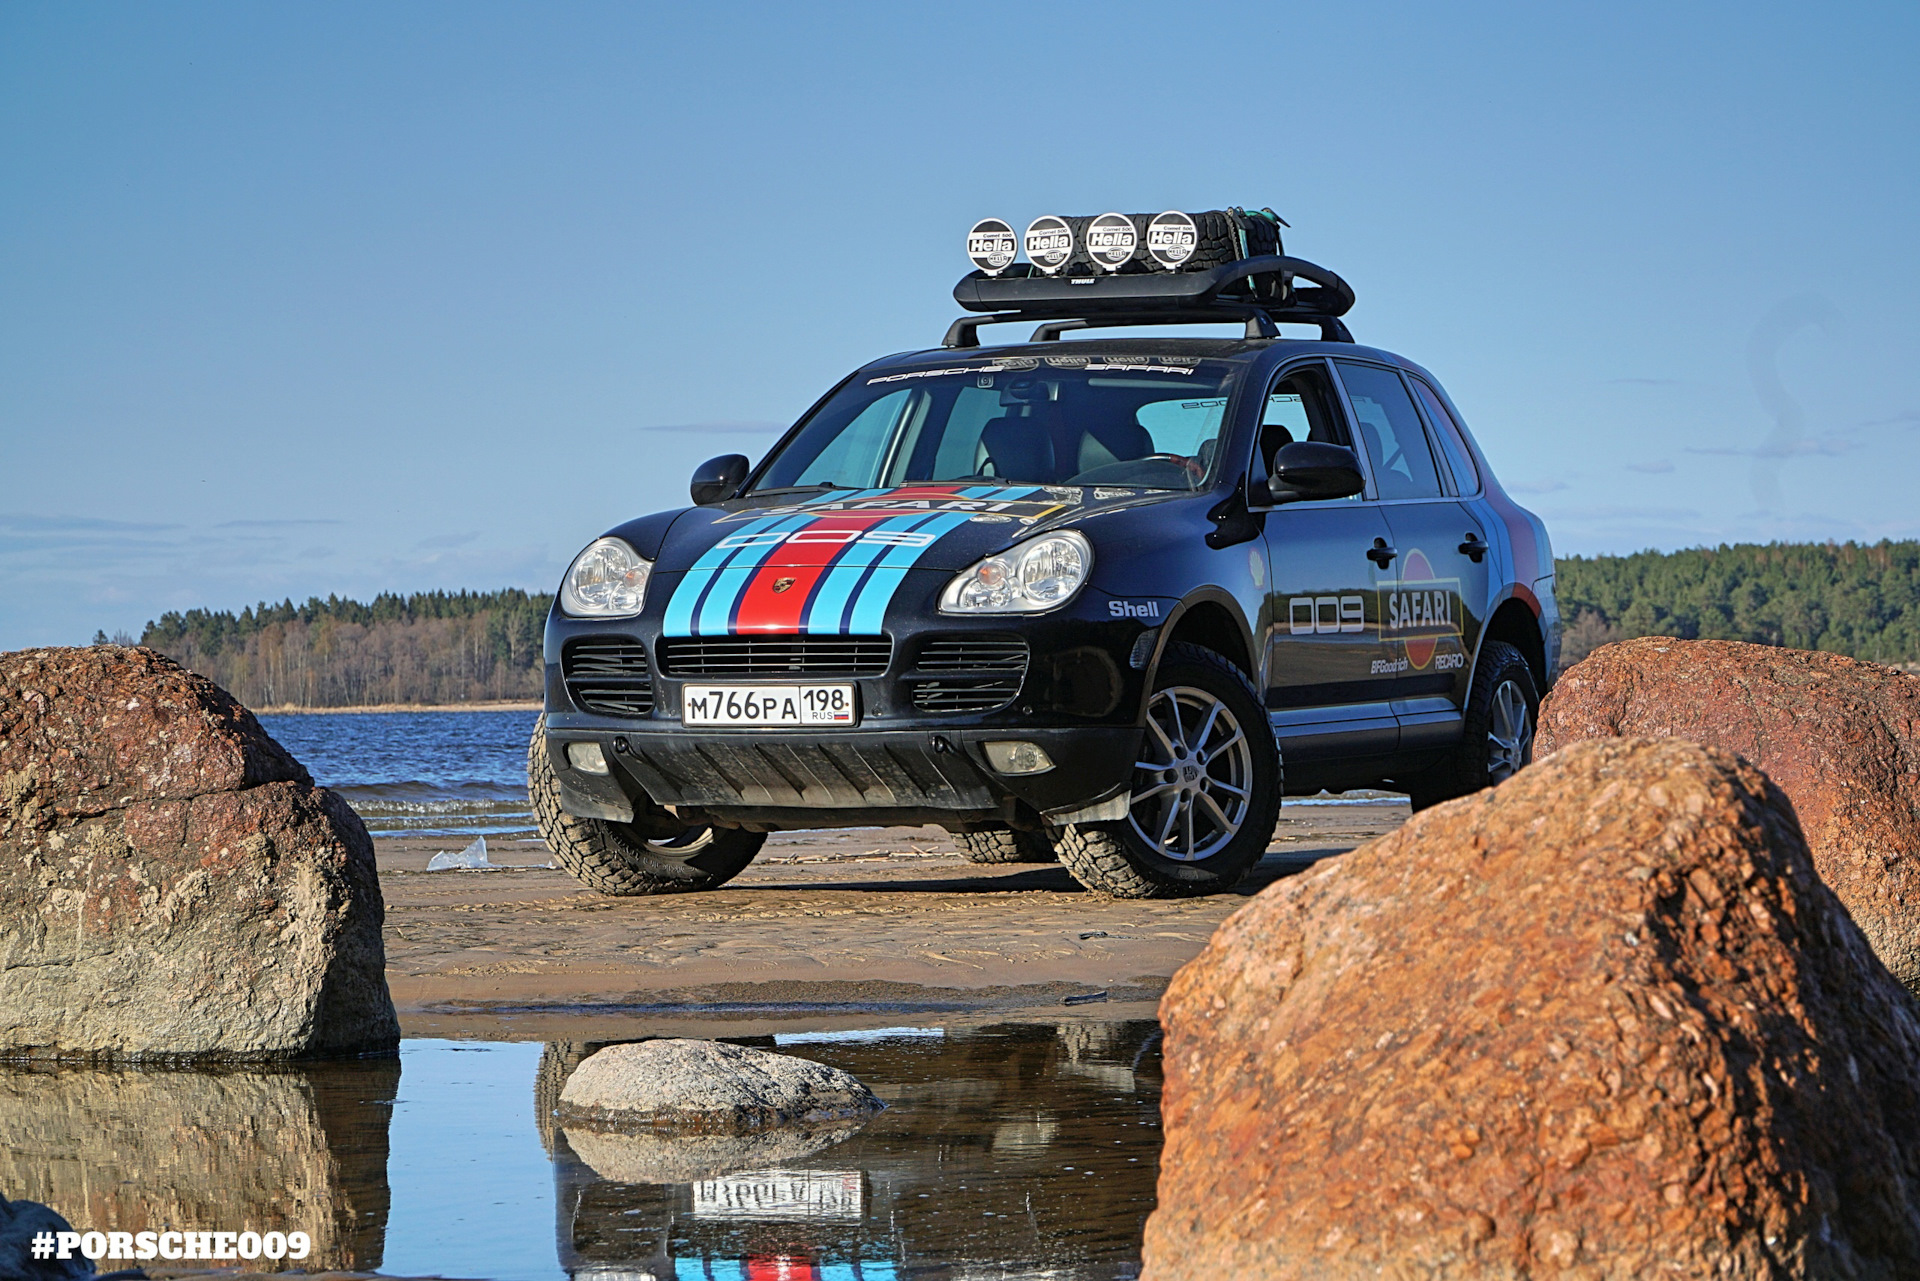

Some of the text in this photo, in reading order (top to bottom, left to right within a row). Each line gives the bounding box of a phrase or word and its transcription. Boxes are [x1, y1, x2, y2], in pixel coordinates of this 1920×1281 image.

[970, 239, 1013, 252] Hella
[1028, 235, 1069, 250] Hella
[1091, 233, 1133, 246] Hella
[1150, 231, 1193, 244] Hella
[867, 364, 1194, 385] PORSCHE SAFARI
[761, 500, 1014, 515] SAFARI
[716, 530, 936, 549] 009
[1109, 600, 1159, 617] Shell
[1289, 595, 1364, 635] 009
[1389, 590, 1451, 629] SAFARI
[1371, 657, 1408, 674] BFGoodrich
[1435, 653, 1464, 670] RECARO
[803, 689, 844, 711] 198
[812, 712, 833, 720] RUS
